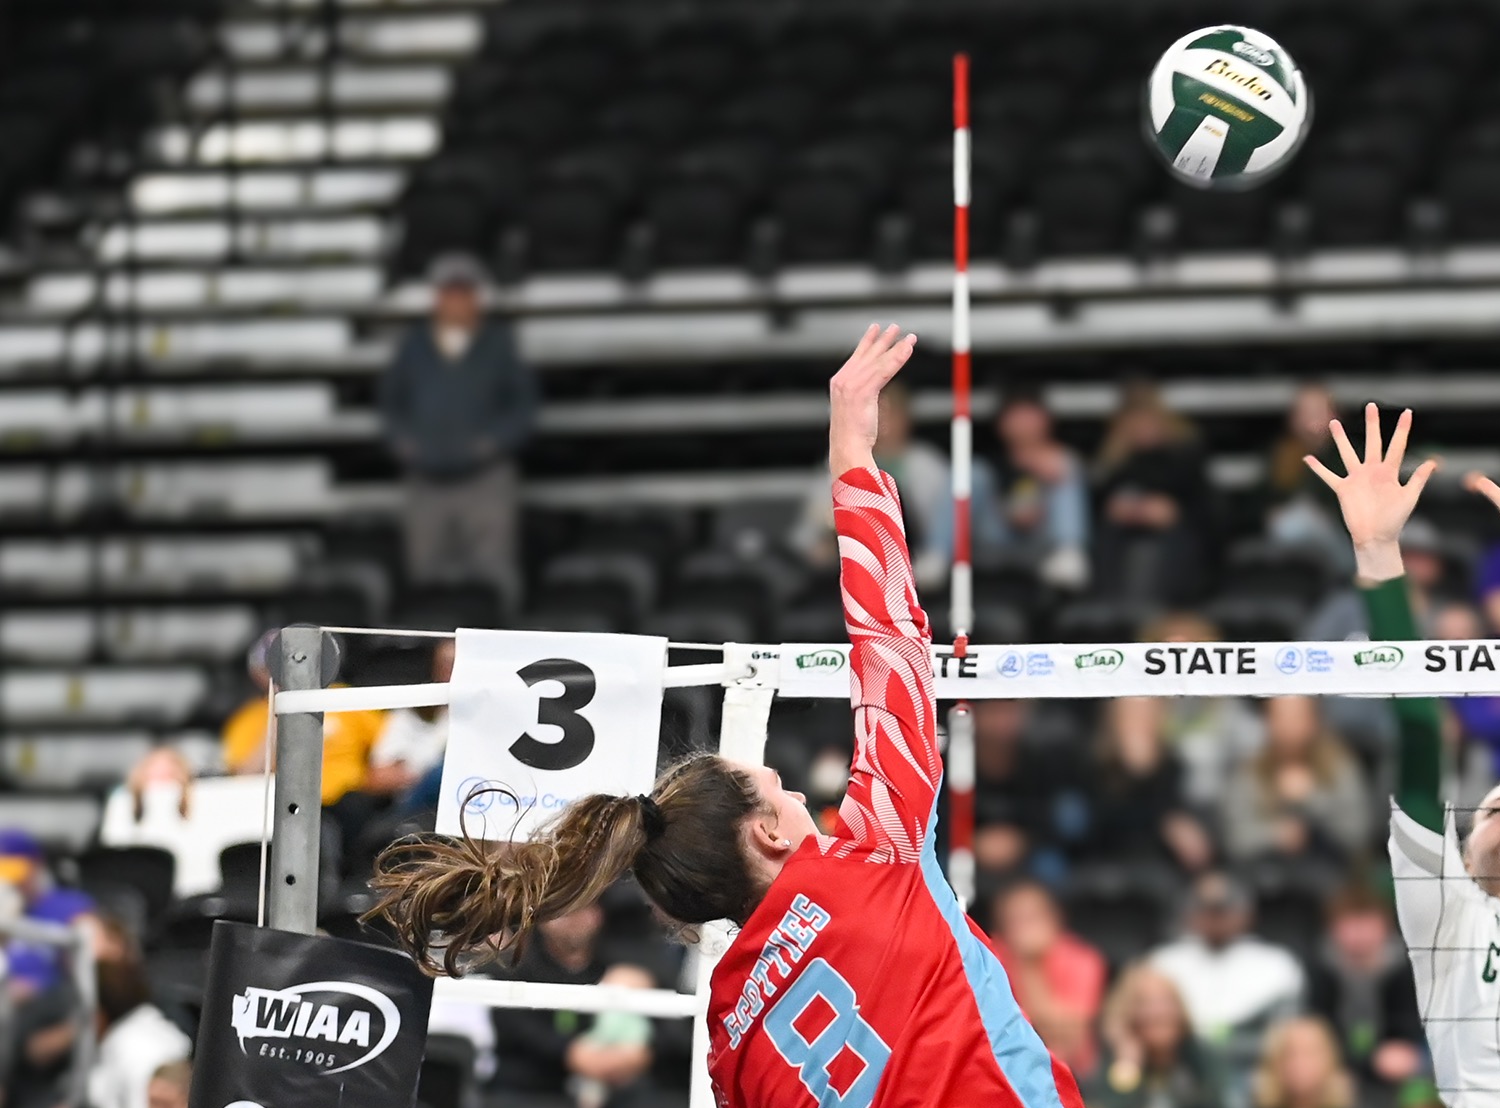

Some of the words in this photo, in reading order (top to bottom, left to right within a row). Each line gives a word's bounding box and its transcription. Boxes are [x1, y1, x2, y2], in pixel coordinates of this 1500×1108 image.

[1204, 58, 1272, 101] Baden
[1145, 648, 1256, 675] STATE
[508, 657, 597, 771] 3
[723, 892, 832, 1050] SCOTTIES
[255, 994, 371, 1048] WIAA
